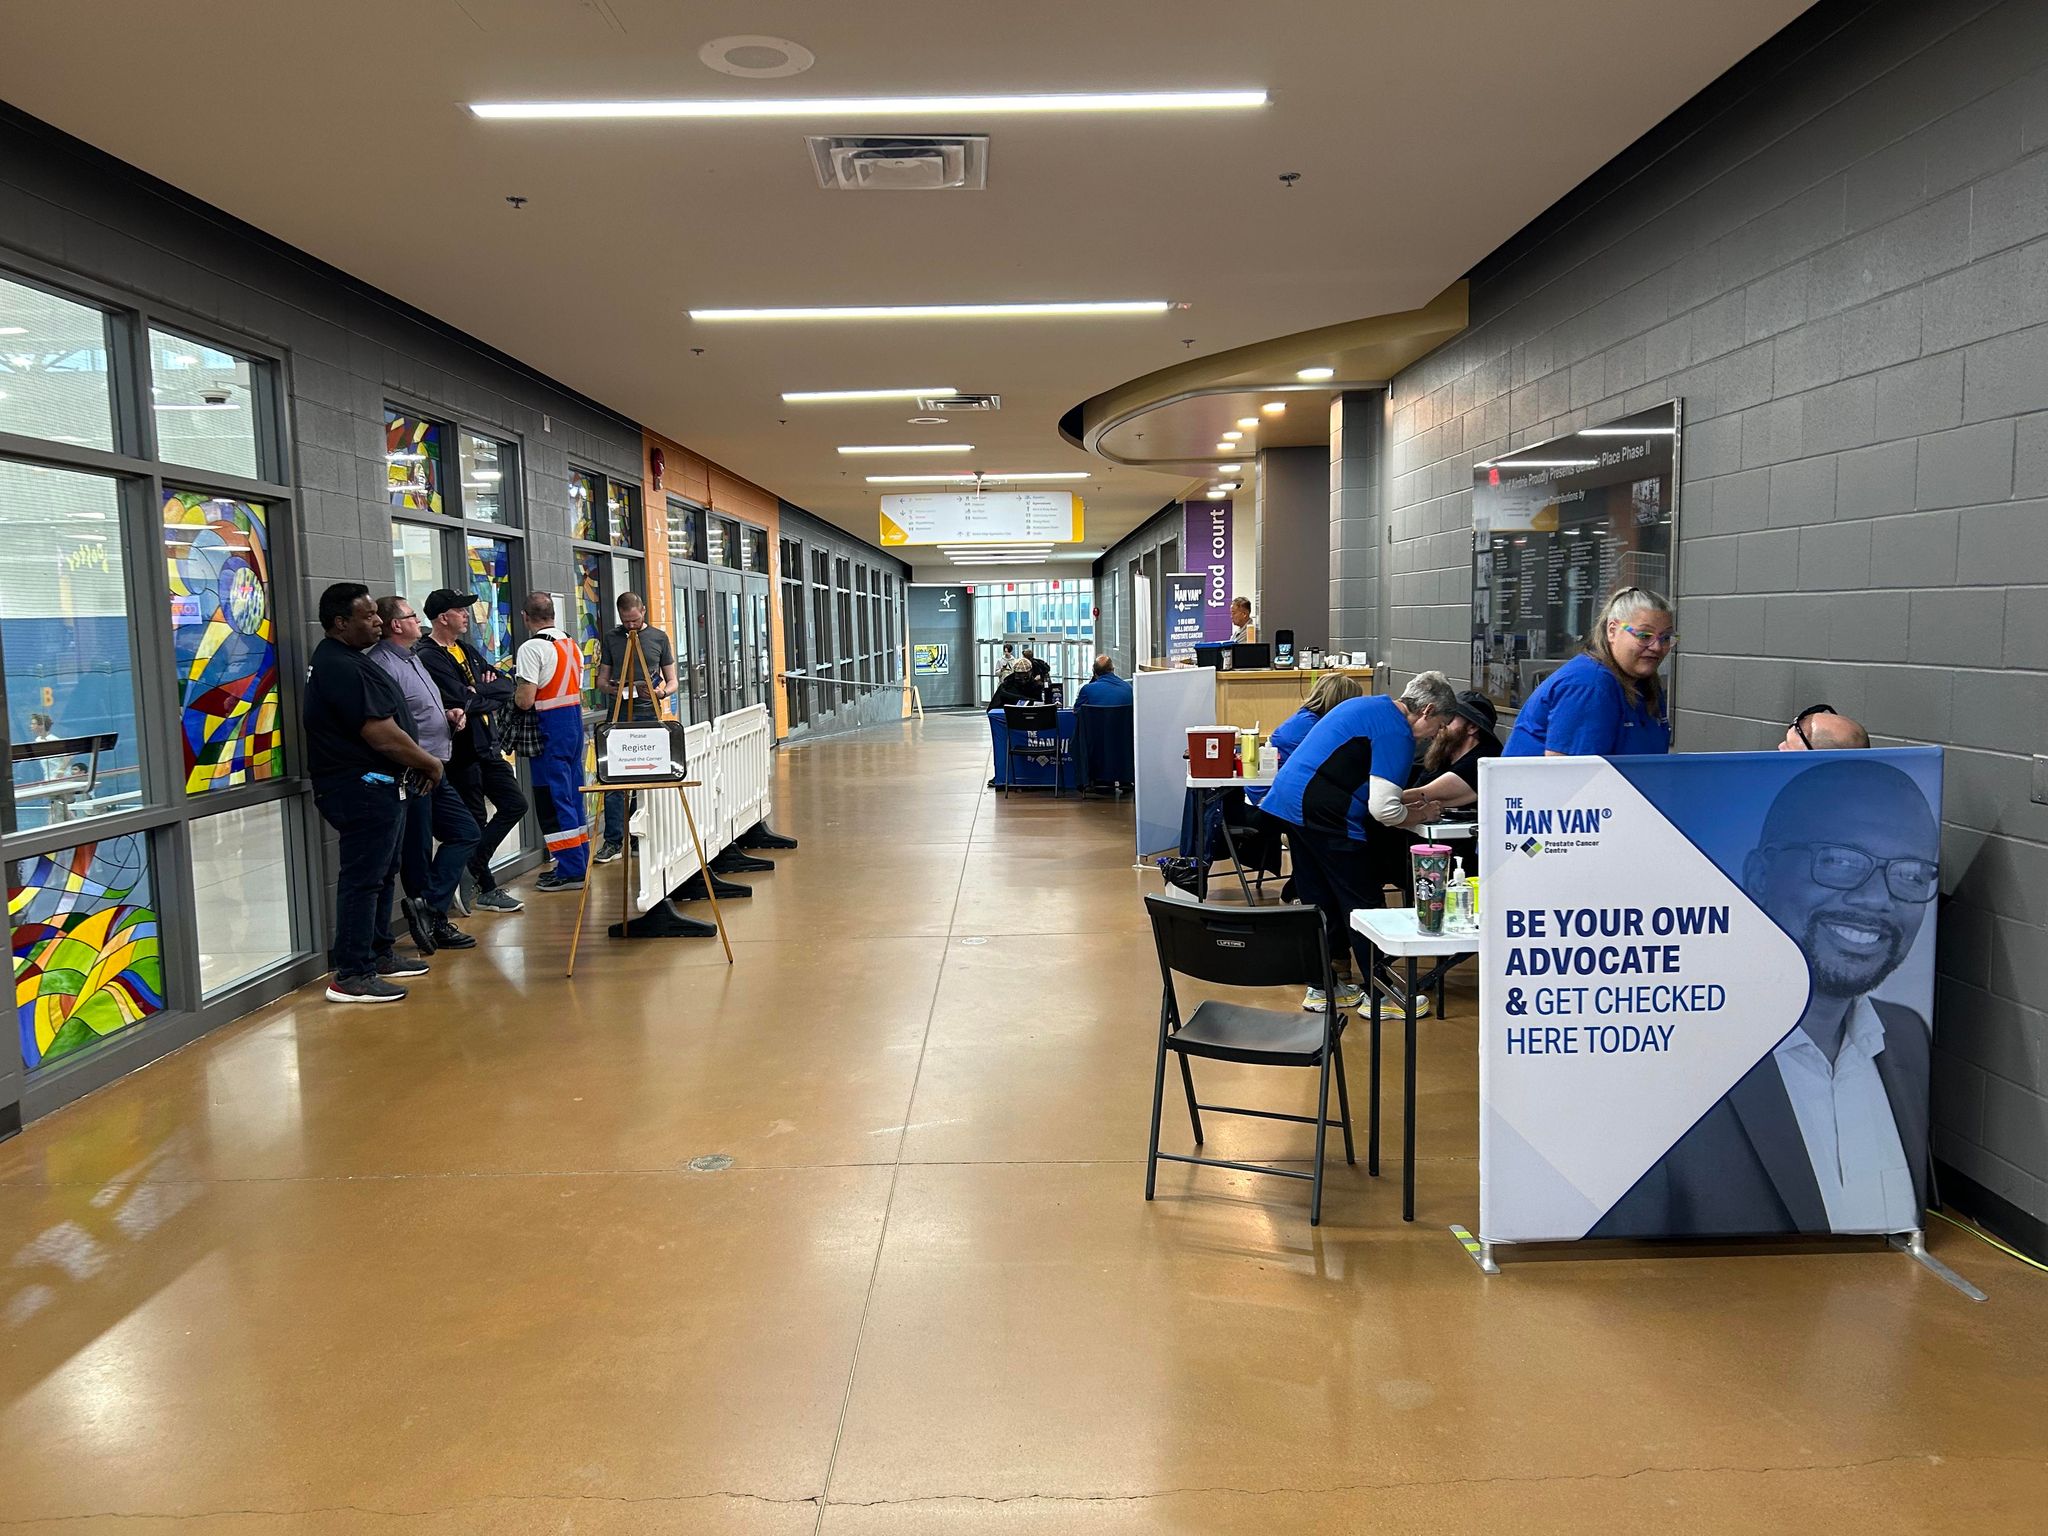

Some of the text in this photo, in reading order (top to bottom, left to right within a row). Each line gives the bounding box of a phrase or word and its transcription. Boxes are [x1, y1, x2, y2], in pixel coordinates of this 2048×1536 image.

[1601, 451, 1621, 466] Place
[1621, 446, 1644, 462] Phase
[1208, 509, 1225, 608] food court
[1027, 730, 1038, 738] THE
[621, 744, 656, 753] Register
[1504, 797, 1523, 809] THE
[1505, 809, 1553, 835] MAN
[1505, 842, 1518, 852] By
[1575, 839, 1600, 847] Cancer
[1505, 906, 1730, 938] BE YOUR OWN
[1505, 945, 1681, 976] ADVOCATE
[1505, 984, 1726, 1016] & GET CHECKED
[1506, 1024, 1676, 1055] HERE TODAY
